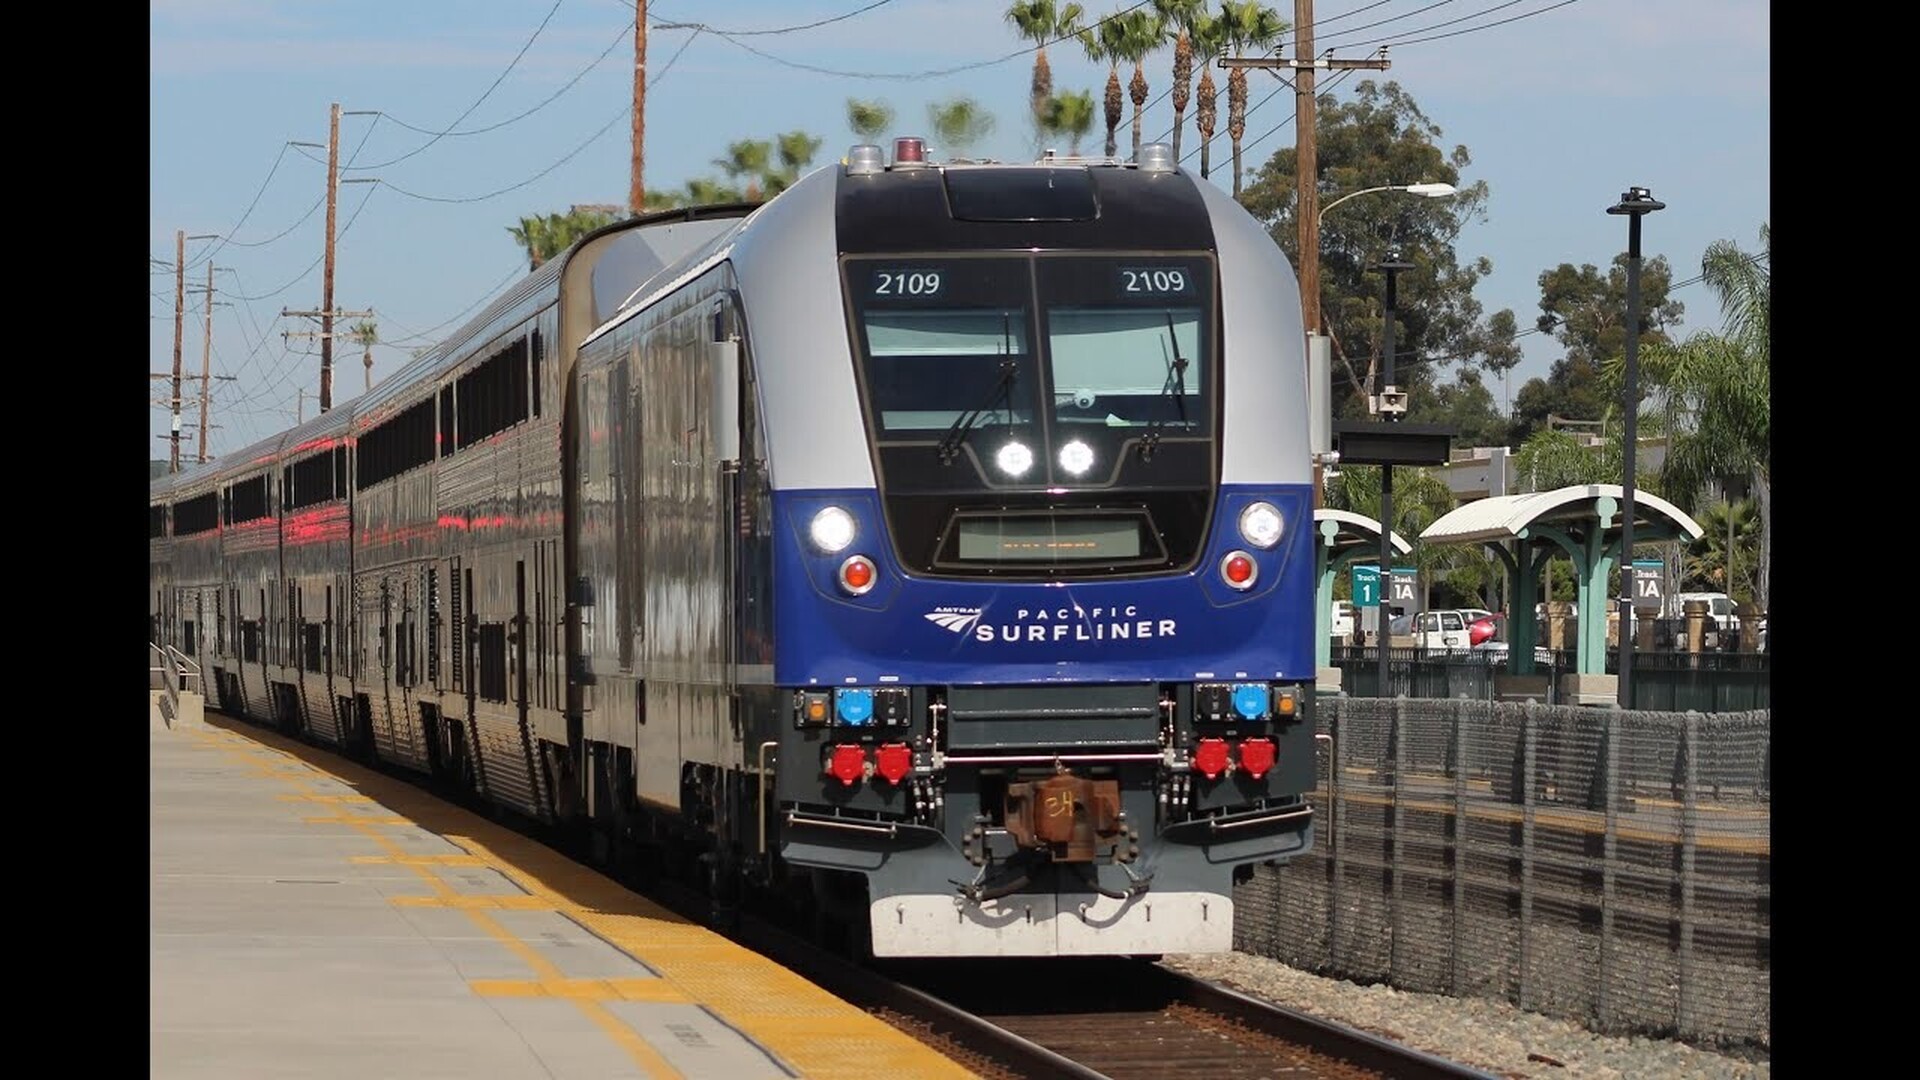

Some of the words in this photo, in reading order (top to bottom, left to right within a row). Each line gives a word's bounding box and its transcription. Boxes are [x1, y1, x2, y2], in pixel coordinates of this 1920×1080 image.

[875, 273, 940, 294] 2109
[1122, 270, 1185, 292] 2109
[1356, 574, 1376, 582] Track
[1637, 569, 1658, 578] Track
[1362, 584, 1370, 602] 1
[1394, 584, 1414, 600] 1A
[1637, 580, 1660, 598] 1A
[934, 606, 982, 614] AMTRAK
[1018, 605, 1137, 620] PACIFIC
[976, 619, 1176, 642] SURFLINER
